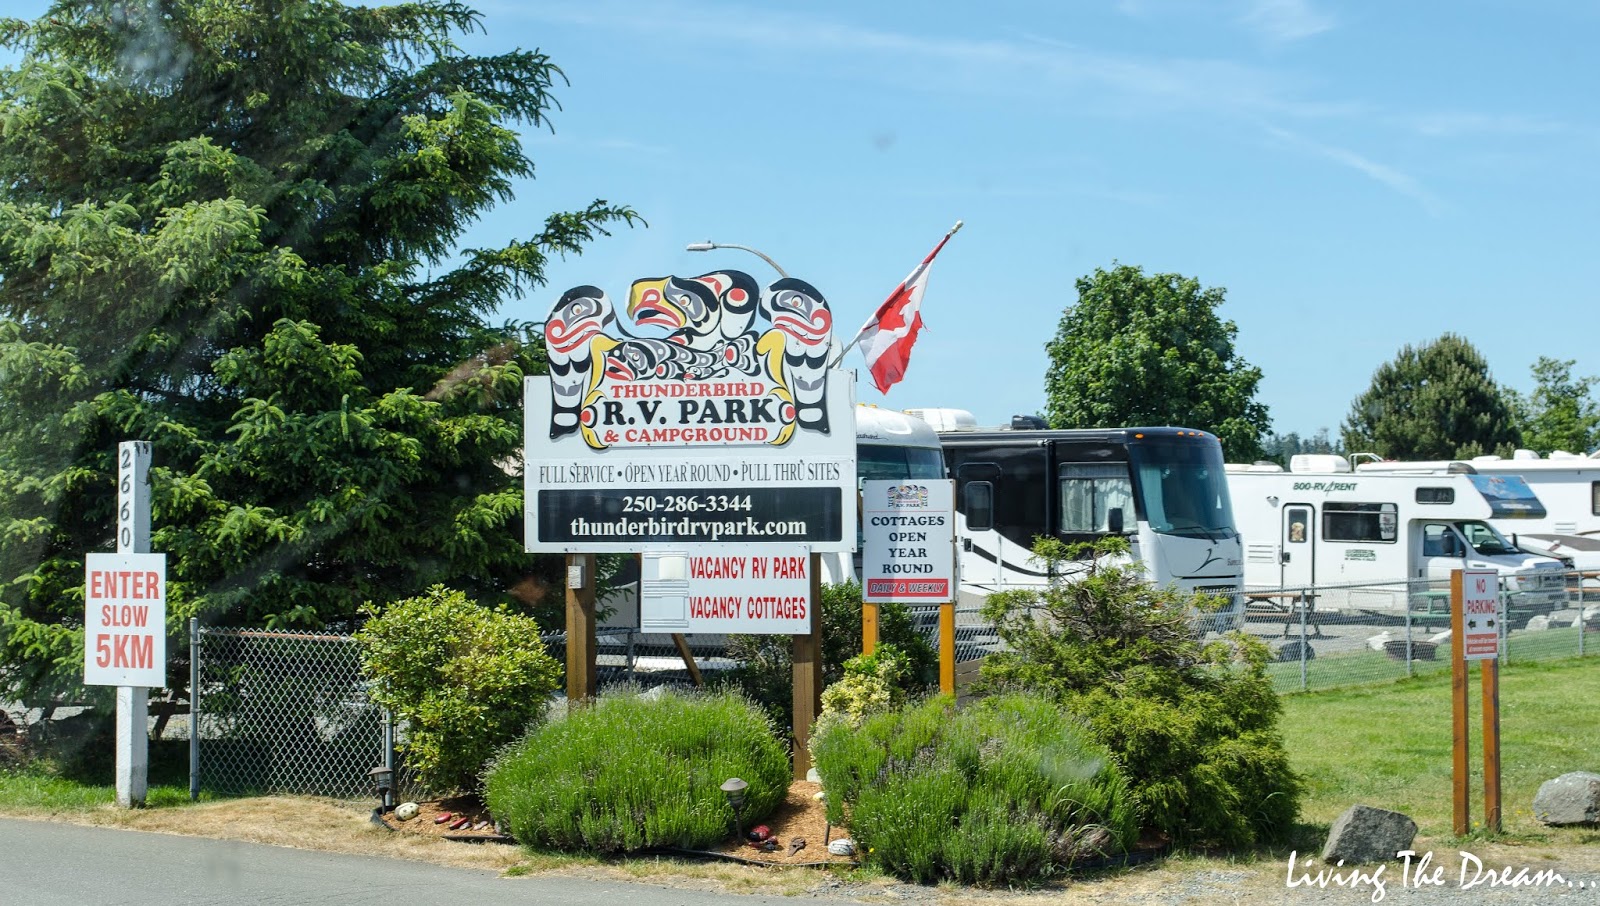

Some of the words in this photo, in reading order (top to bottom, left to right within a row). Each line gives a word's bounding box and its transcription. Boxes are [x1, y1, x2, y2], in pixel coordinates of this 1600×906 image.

[611, 382, 765, 398] THUNDERBIRD
[603, 400, 667, 425] R.V.
[679, 399, 776, 425] PARK
[603, 430, 619, 443] &
[626, 427, 768, 443] CAMPGROUND
[540, 465, 567, 483] FULL
[570, 464, 615, 483] SERVICE
[625, 464, 656, 482] OPEN
[658, 464, 688, 482] YEAR
[690, 464, 731, 482] ROUND
[741, 463, 772, 481] PULL
[774, 462, 805, 481] THRU
[807, 462, 840, 481] SITES
[120, 448, 131, 548] 2660
[622, 495, 752, 512] 250-286-3344
[570, 517, 807, 540] thunderbirdrvpark.com
[871, 516, 945, 526] COTTAGES
[889, 532, 927, 542] OPEN
[888, 548, 928, 558] YEAR
[690, 556, 747, 579] VACANCY
[752, 556, 768, 579] RV
[773, 556, 806, 579] PARK
[882, 564, 933, 574] ROUND
[91, 571, 159, 599] ENTER
[870, 583, 897, 593] DAILY
[899, 583, 906, 593] &
[909, 583, 945, 593] WEEKLY
[1476, 578, 1486, 594] NO
[689, 596, 742, 619] VACANCY
[747, 596, 806, 619] COTTAGES
[1467, 599, 1496, 614] PARKING
[101, 604, 149, 627] SLOW
[96, 633, 154, 669] 5KM
